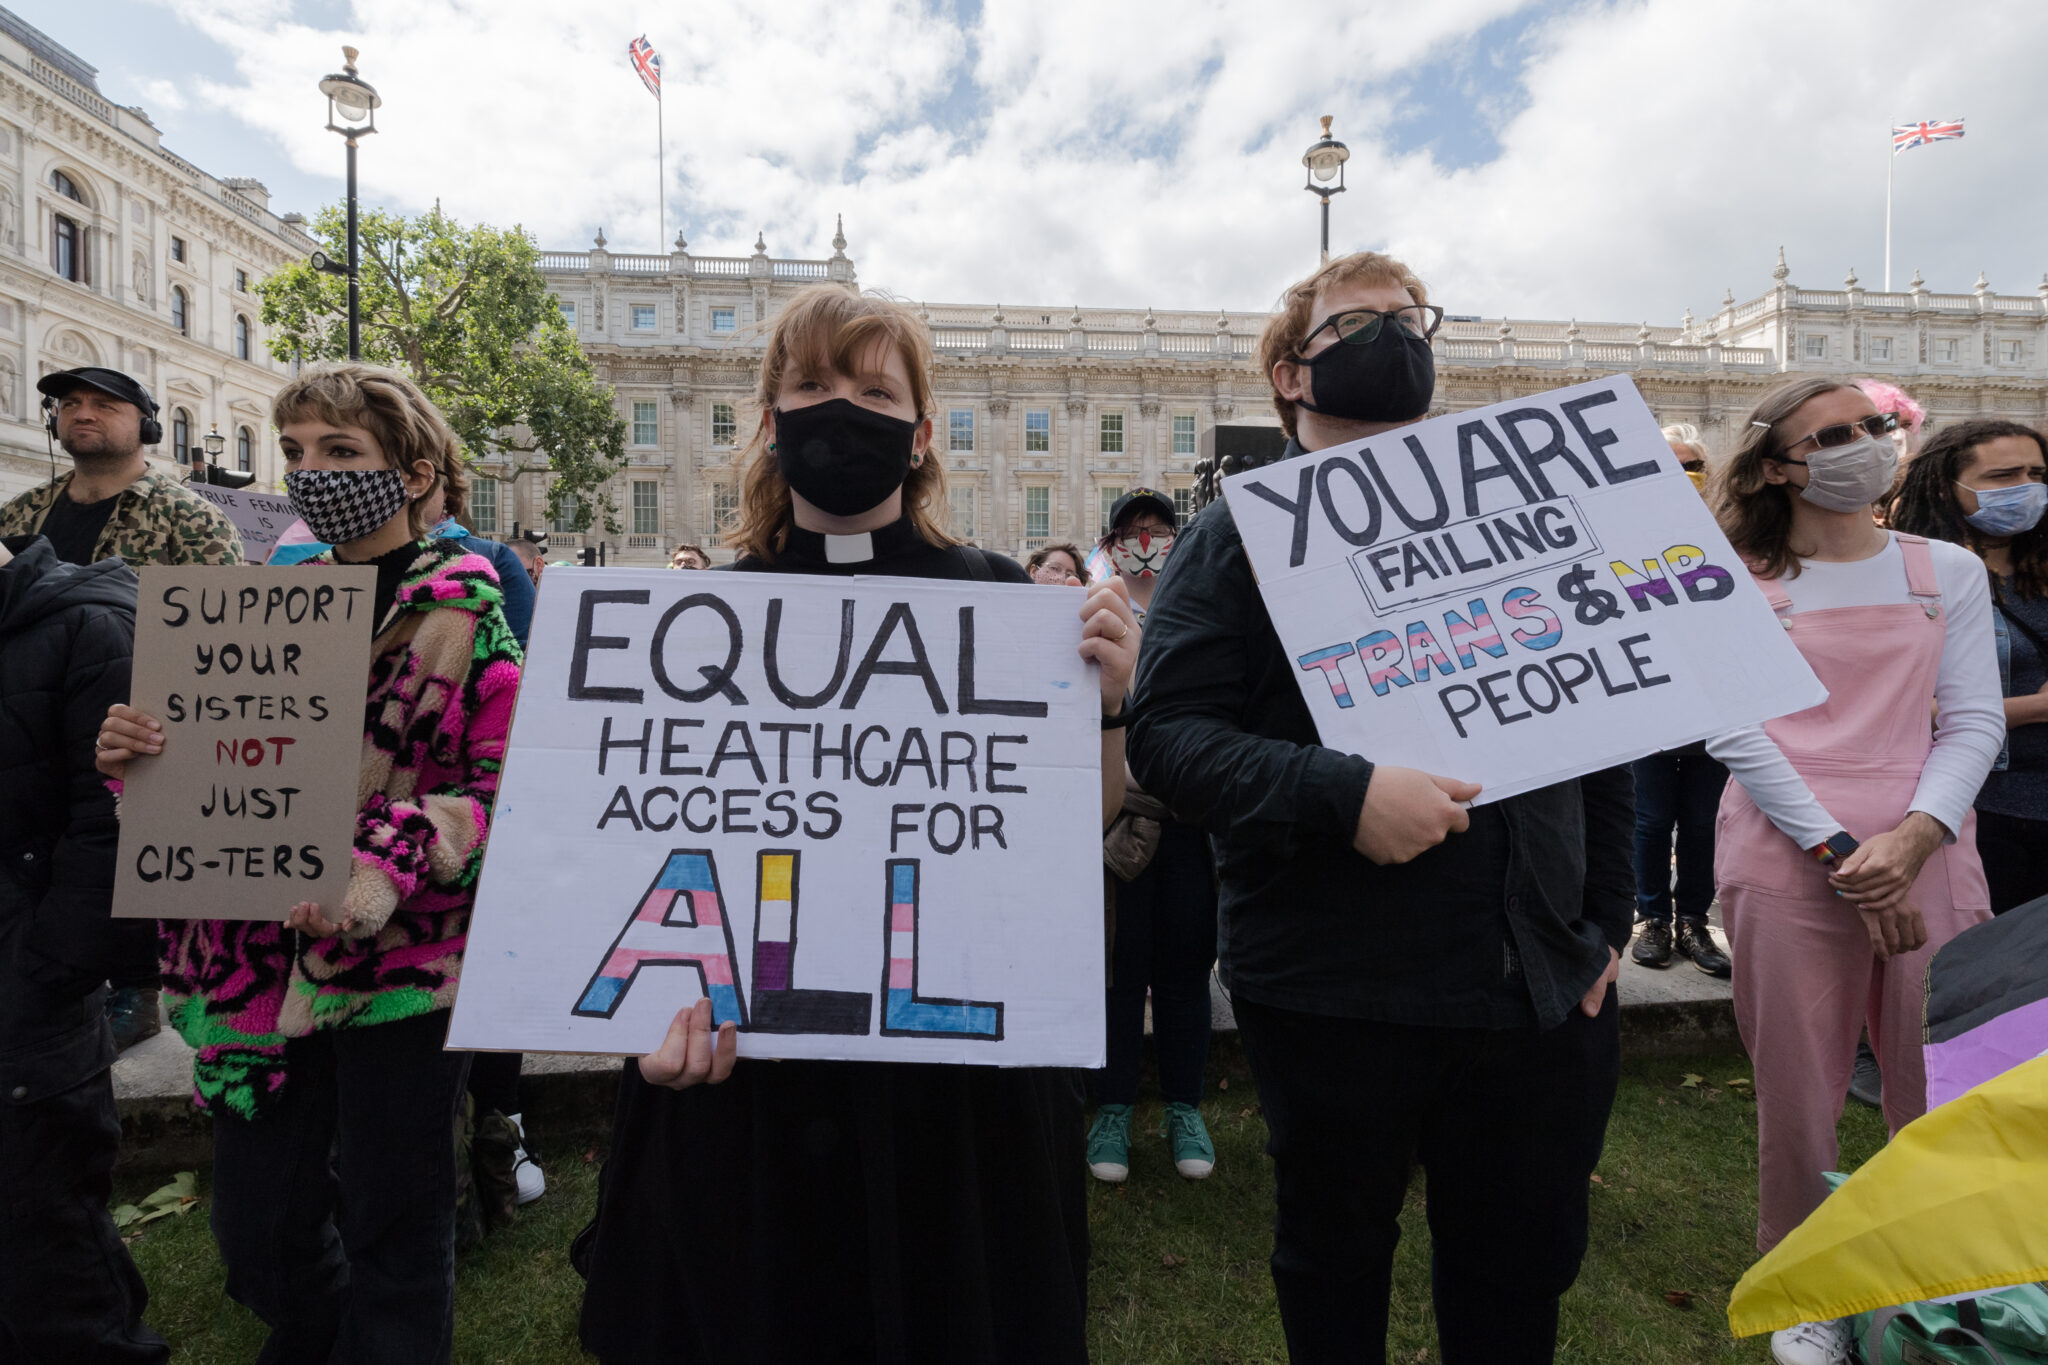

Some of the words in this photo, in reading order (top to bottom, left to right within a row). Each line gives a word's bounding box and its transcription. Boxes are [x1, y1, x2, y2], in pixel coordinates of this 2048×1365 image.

[1242, 434, 1451, 568] YOU
[1457, 389, 1661, 517] ARE
[249, 498, 298, 516] FEMIN
[258, 517, 273, 528] IS
[1367, 505, 1578, 593] FAILING
[162, 586, 365, 626] SUPPORT
[1297, 587, 1563, 709] TRANS
[1609, 544, 1736, 613] NB
[194, 643, 300, 675] YOUR
[567, 589, 1048, 717] EQUAL
[166, 693, 329, 722] SISTERS
[1437, 633, 1671, 739] PEOPLE
[216, 736, 296, 766] NOT
[598, 717, 1028, 793] HEATHCARE
[201, 785, 301, 819] JUST
[597, 785, 842, 839] ACCESS
[889, 802, 1007, 854] FOR
[136, 844, 324, 881] CIS-TERS
[571, 848, 1004, 1040] ALL
